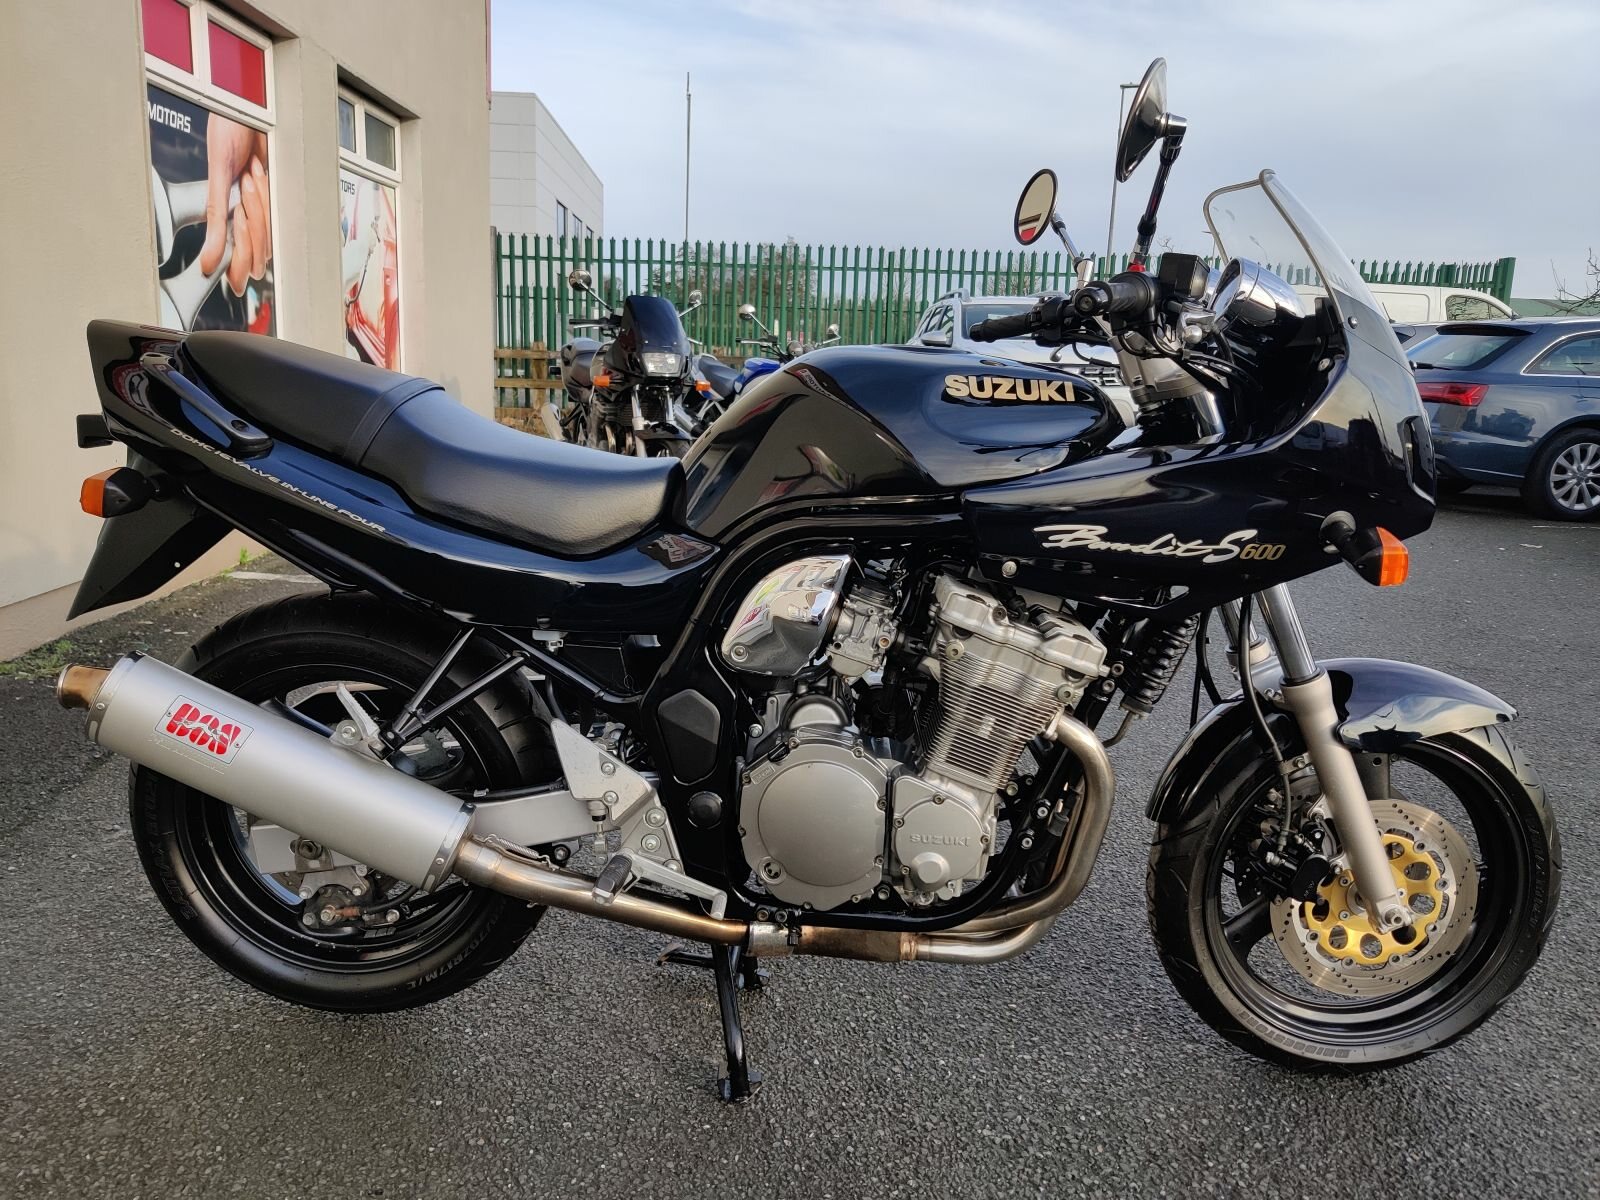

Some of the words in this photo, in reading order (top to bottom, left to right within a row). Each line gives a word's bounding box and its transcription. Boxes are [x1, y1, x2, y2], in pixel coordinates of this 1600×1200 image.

[147, 101, 192, 134] MOTORS
[944, 374, 1076, 402] SUZUKI
[170, 428, 215, 452] DOHC
[337, 509, 386, 532] FOUR
[909, 833, 971, 848] SUZUKI
